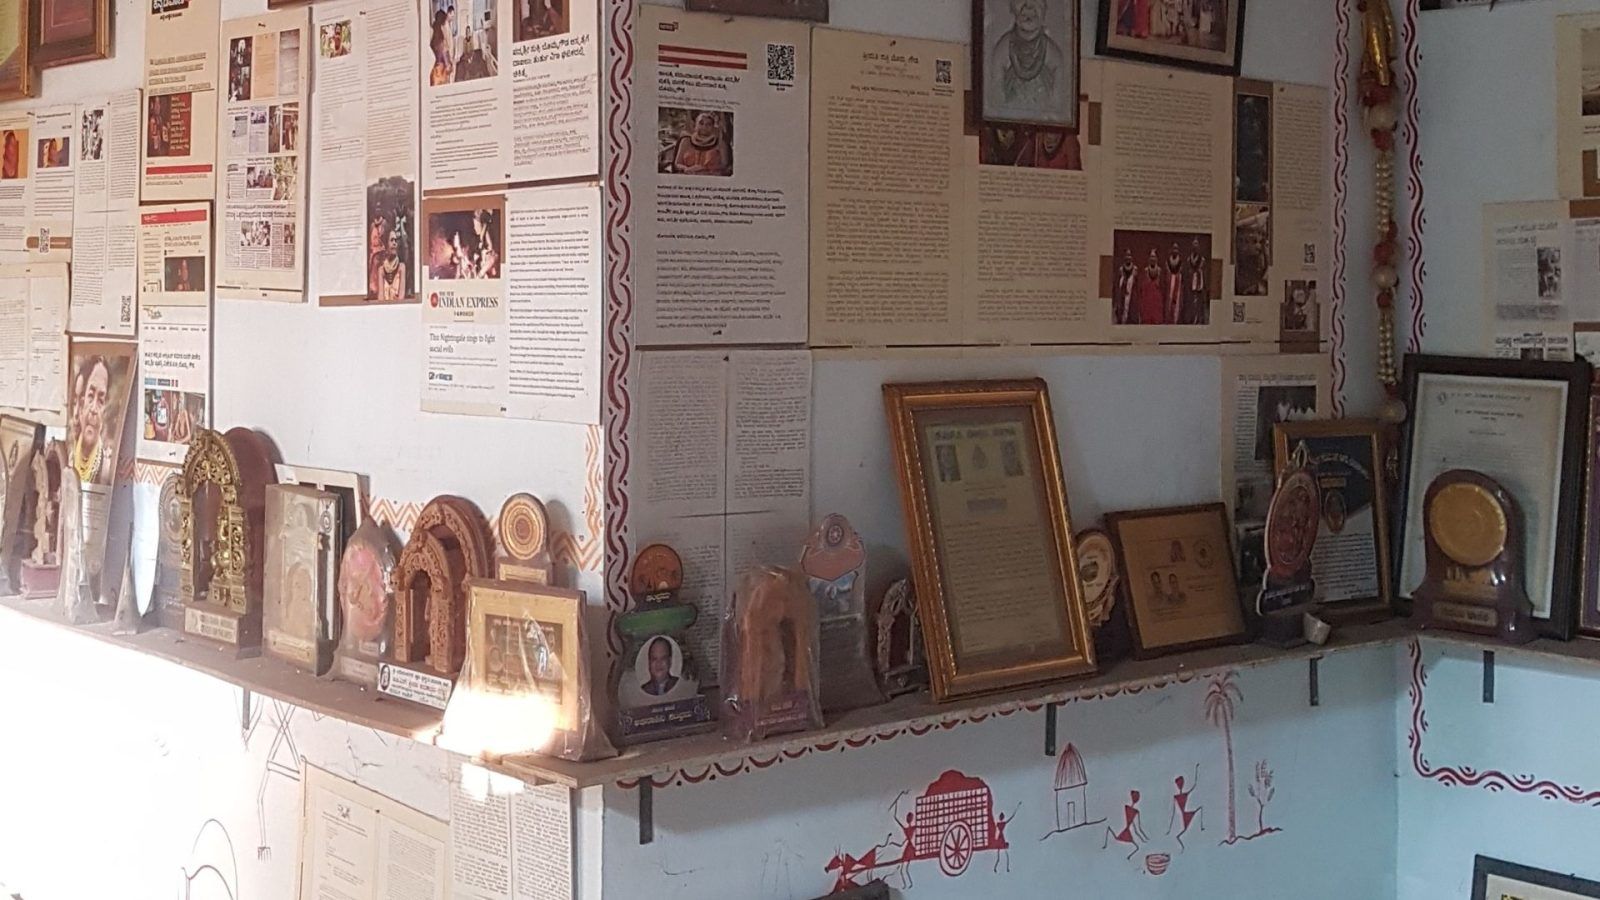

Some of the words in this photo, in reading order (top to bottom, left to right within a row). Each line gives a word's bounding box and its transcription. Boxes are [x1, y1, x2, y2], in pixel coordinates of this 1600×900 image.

[439, 296, 465, 308] INDIAN
[466, 297, 499, 308] EXPRESS
[441, 333, 465, 343] Nightingale
[466, 335, 477, 344] sings
[485, 333, 496, 344] fight
[443, 345, 453, 353] evils
